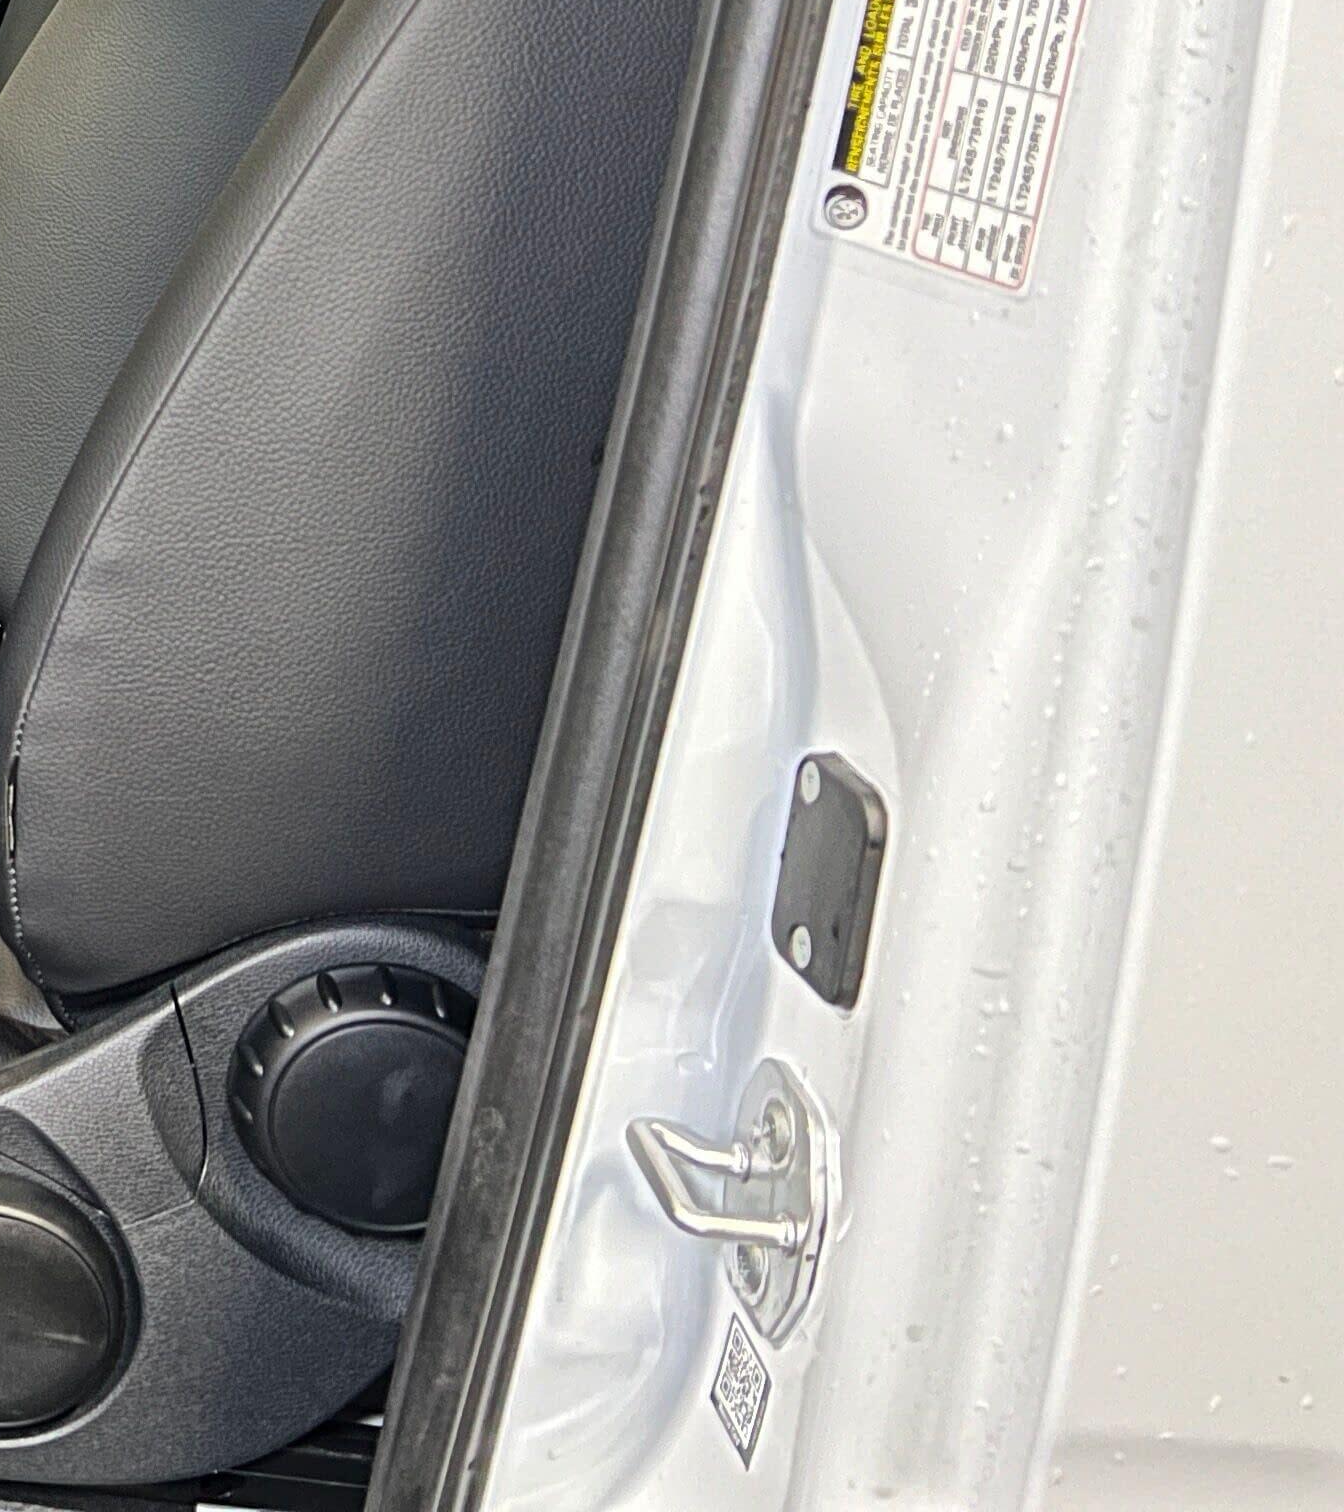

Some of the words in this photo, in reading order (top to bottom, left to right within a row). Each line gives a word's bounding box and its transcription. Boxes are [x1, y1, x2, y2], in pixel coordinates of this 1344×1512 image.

[895, 13, 914, 51] TOTAL
[854, 44, 872, 75] AND
[846, 81, 864, 111] TIRE
[844, 58, 882, 172] RENSEIGNEMENTS
